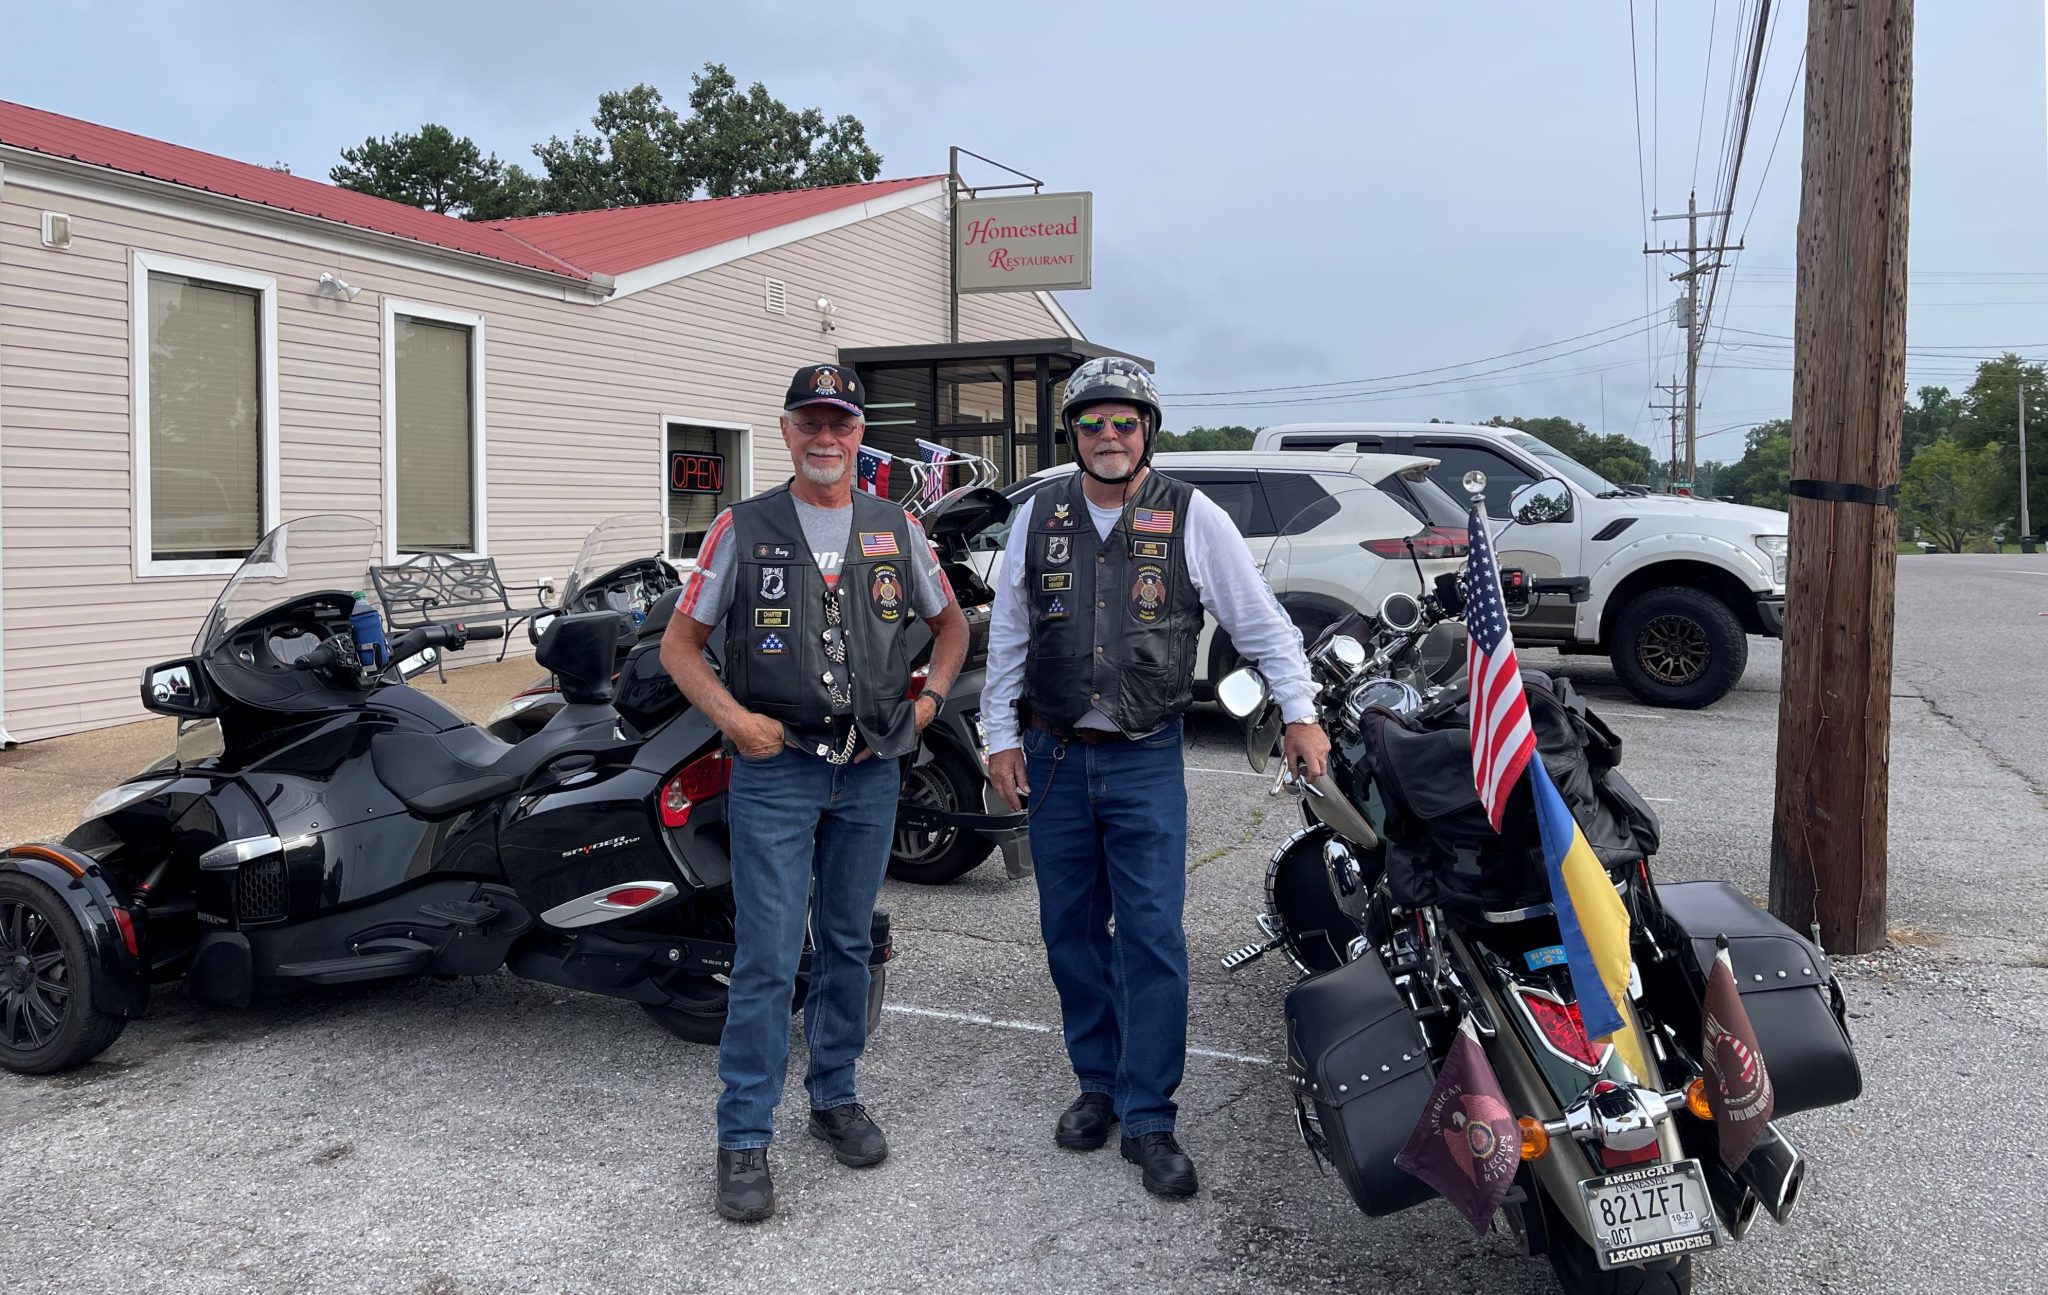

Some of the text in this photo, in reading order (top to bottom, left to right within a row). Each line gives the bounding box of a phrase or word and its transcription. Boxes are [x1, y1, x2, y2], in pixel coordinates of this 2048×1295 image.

[965, 216, 1078, 246] Homestead
[673, 457, 721, 490] OPEN
[562, 836, 626, 857] SPYDER
[1431, 1083, 1462, 1136] AMERICAN
[1728, 1109, 1746, 1121] YOU
[1743, 1103, 1760, 1119] ARE
[1483, 1135, 1507, 1172] LEGION
[1484, 1134, 1514, 1182] RIDERS
[1604, 1165, 1675, 1186] AMERICAN
[1615, 1177, 1668, 1194] TENNESSEE
[1600, 1183, 1686, 1227] 821ZF7
[1671, 1211, 1694, 1222] 10-23
[1609, 1234, 1712, 1263] LEGION RIDERS
[1611, 1227, 1632, 1246] OCT
